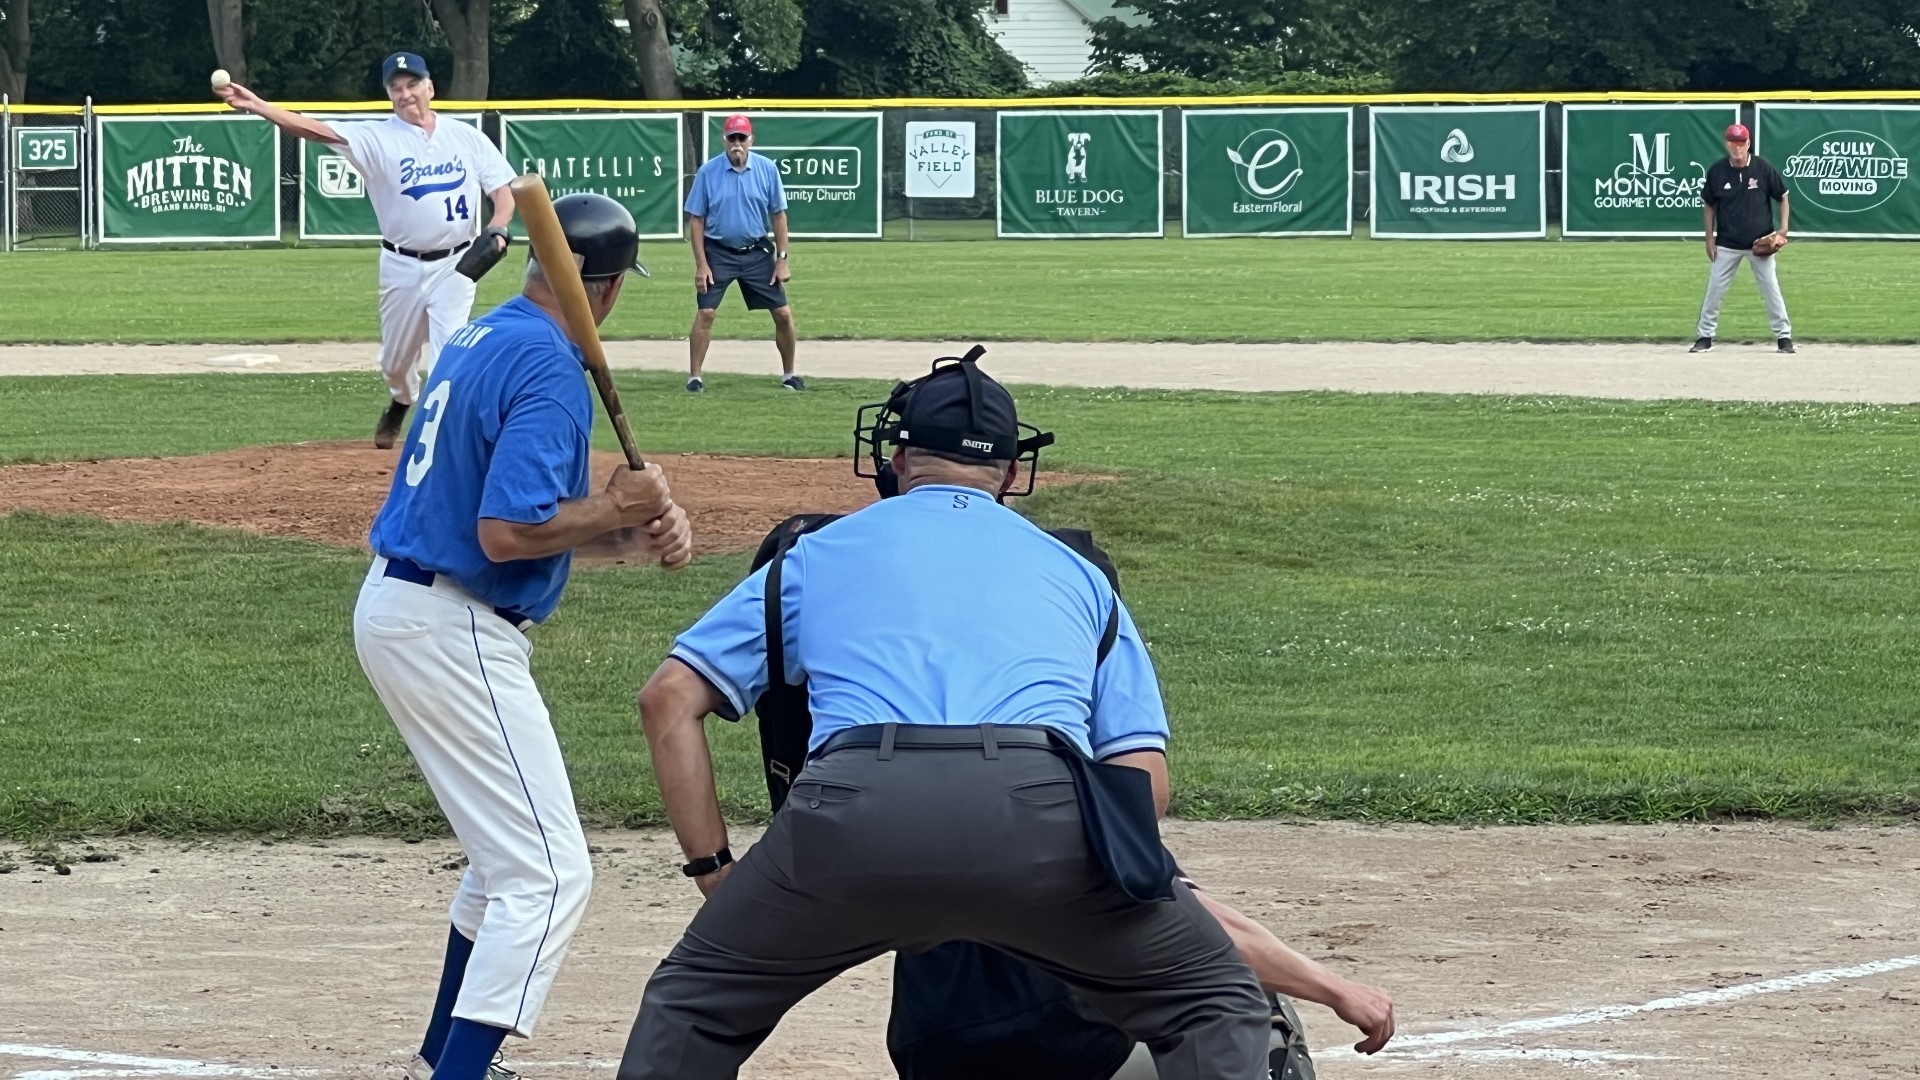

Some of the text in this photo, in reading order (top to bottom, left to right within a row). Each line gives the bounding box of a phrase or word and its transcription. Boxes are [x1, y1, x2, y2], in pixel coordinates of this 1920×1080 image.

[28, 139, 67, 161] 375
[173, 135, 205, 153] The
[909, 143, 970, 160] VALLEY
[1822, 142, 1875, 155] SCULLY
[523, 156, 662, 178] FRATELLI'S
[773, 158, 849, 175] STONE
[918, 161, 961, 171] FIELD
[1782, 155, 1908, 179] STATEWIDE
[127, 155, 252, 202] MITTEN
[1595, 178, 1707, 196] MONICA'S
[1821, 181, 1874, 192] MOVING
[783, 188, 856, 203] unity Church
[1035, 189, 1124, 204] BLUE DOG
[1400, 172, 1516, 205] IRISH
[141, 189, 239, 208] BREWING CO.
[1233, 201, 1302, 213] EasternFloral
[1594, 197, 1706, 208] GOURMET COOKIE
[152, 203, 180, 214] GRAND
[444, 194, 469, 222] 14
[406, 380, 450, 487] 3
[962, 438, 994, 453] SMITTY
